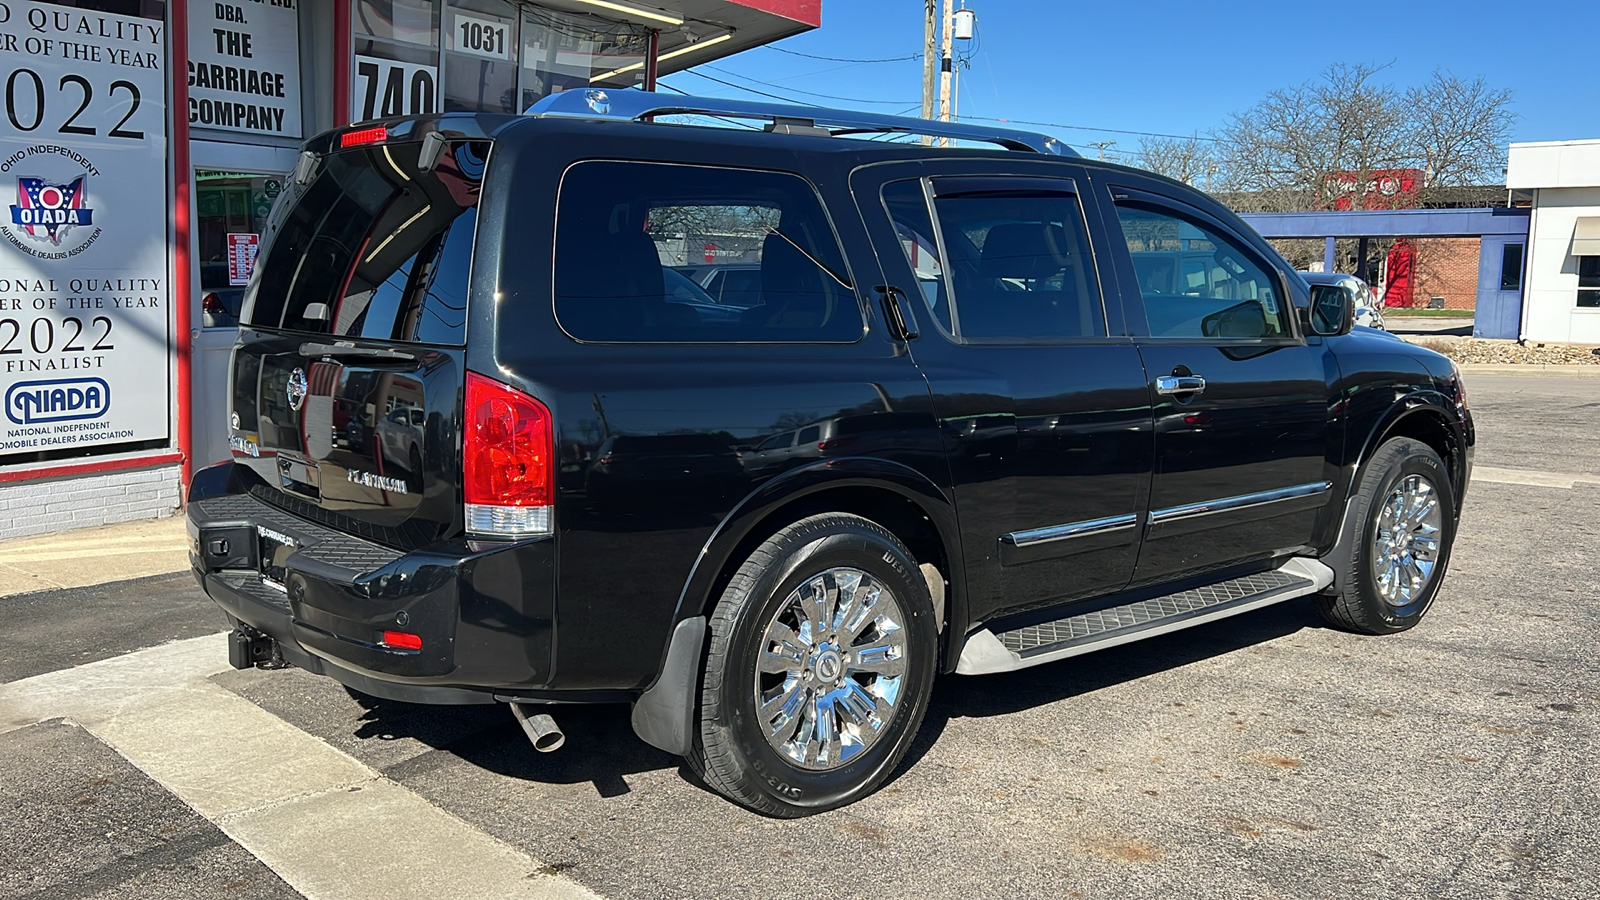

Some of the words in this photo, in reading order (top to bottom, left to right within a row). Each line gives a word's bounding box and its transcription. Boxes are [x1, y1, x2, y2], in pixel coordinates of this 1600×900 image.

[28, 8, 162, 45] QUALITY
[214, 2, 248, 25] DBA.
[0, 32, 20, 53] R
[25, 37, 54, 56] OF
[59, 41, 102, 62] THE
[107, 47, 160, 70] YEAR
[213, 28, 253, 59] THE
[460, 21, 504, 55] 1031
[187, 60, 286, 98] CARRIAGE
[358, 61, 435, 121] 740
[6, 68, 145, 140] 022
[187, 97, 285, 132] COMPANY
[0, 150, 26, 173] OHIO
[26, 144, 101, 177] INDEPENDENT
[20, 208, 80, 224] OIADA
[0, 225, 37, 257] AUTOMOBILE
[37, 251, 68, 260] DEALERS
[68, 227, 103, 258] ASSOCIATION
[0, 278, 59, 293] ONAL
[69, 278, 161, 295] QUALITY
[0, 298, 23, 311] ER
[32, 297, 58, 311] OF
[66, 296, 104, 310] THE
[112, 296, 159, 309] YEAR
[0, 315, 115, 355] 2022
[6, 356, 105, 373] FINALIST
[14, 386, 101, 418] NIADA
[7, 426, 52, 438] NATIONAL
[53, 421, 111, 434] INDEPENDENT
[40, 435, 77, 446] DEALERS
[78, 429, 134, 442] ASSOCIATION
[347, 468, 408, 495] PLATINUM
